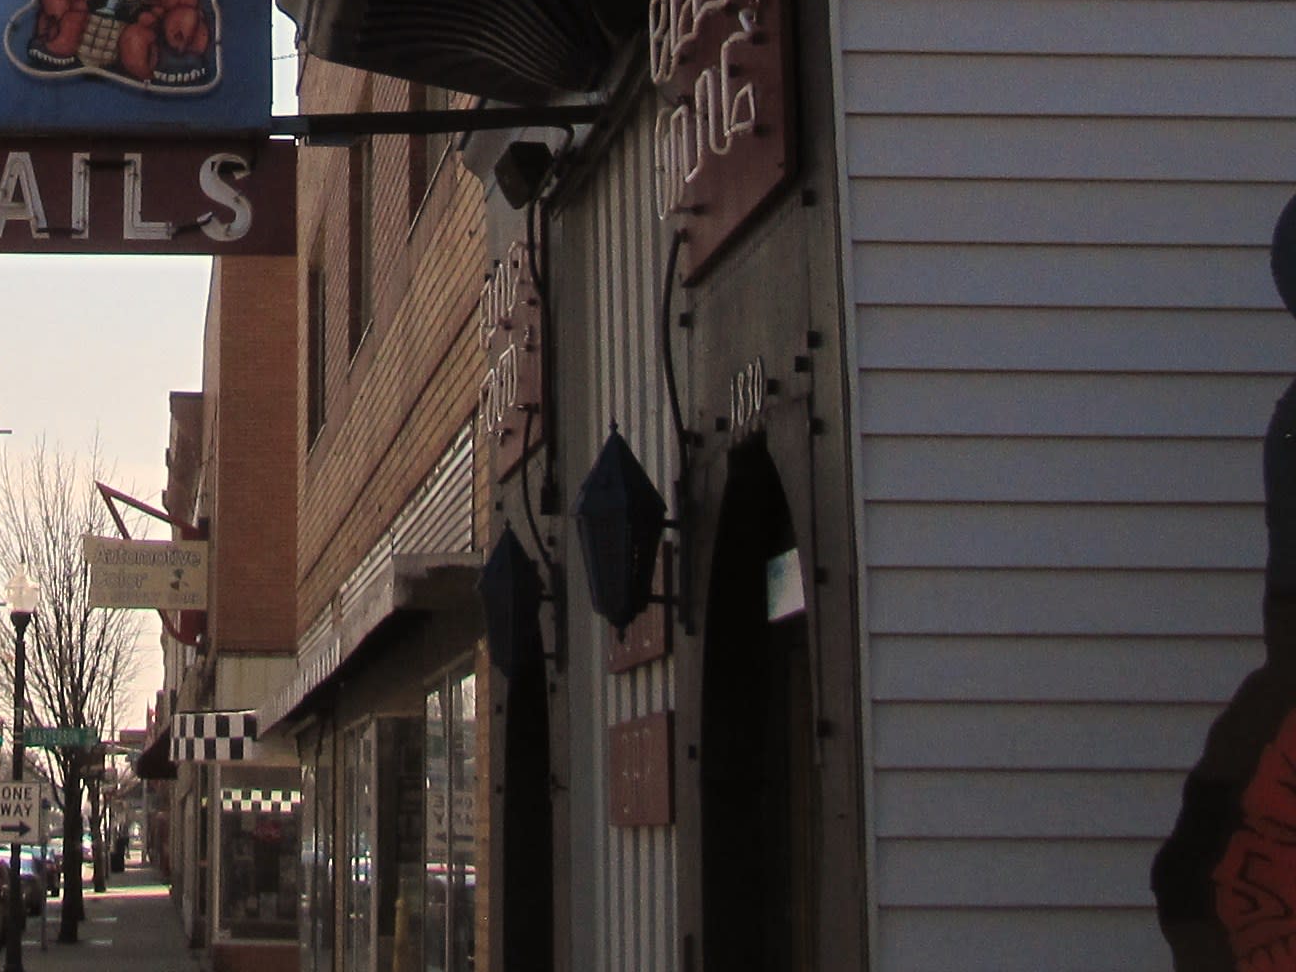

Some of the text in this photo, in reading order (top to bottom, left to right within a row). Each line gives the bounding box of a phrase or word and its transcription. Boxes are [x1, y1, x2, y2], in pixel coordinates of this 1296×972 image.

[730, 356, 762, 432] 1830
[95, 546, 202, 568] Automotive
[2, 786, 33, 802] ONE
[1, 803, 32, 818] WAY
